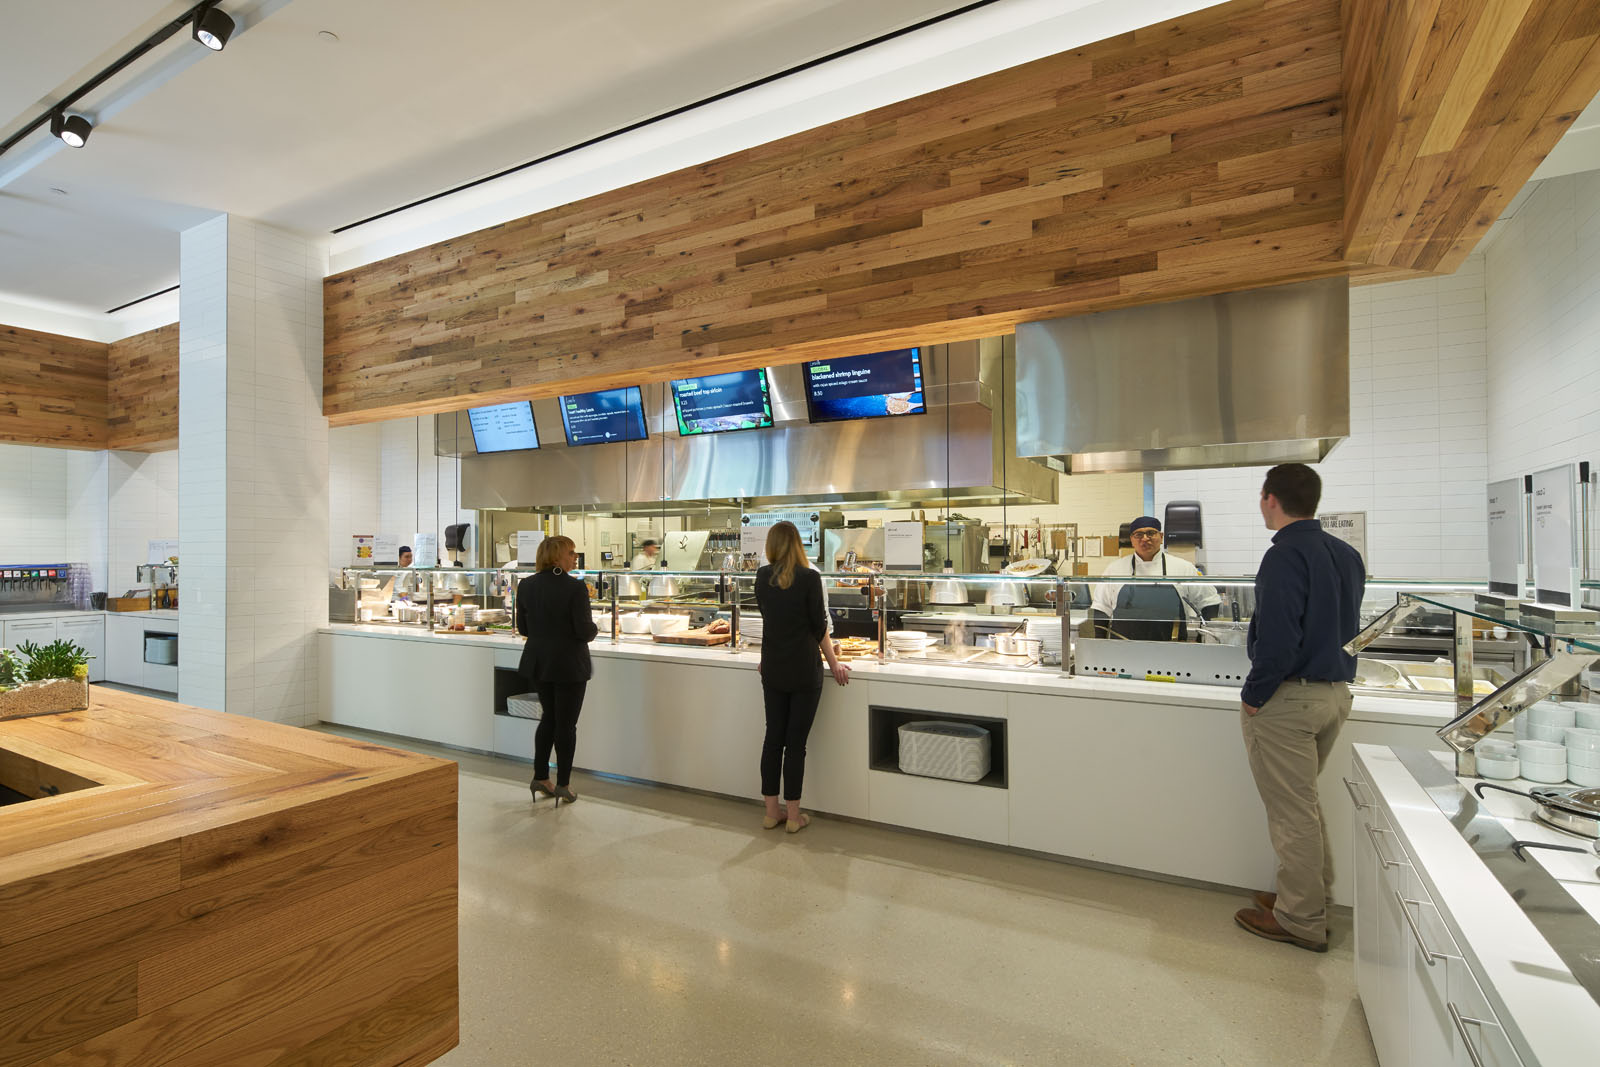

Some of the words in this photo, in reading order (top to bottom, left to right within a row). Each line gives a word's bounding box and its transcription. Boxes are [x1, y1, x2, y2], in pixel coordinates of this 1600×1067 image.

[812, 372, 834, 380] blackened
[852, 368, 871, 376] linguine
[1338, 520, 1354, 528] EATING
